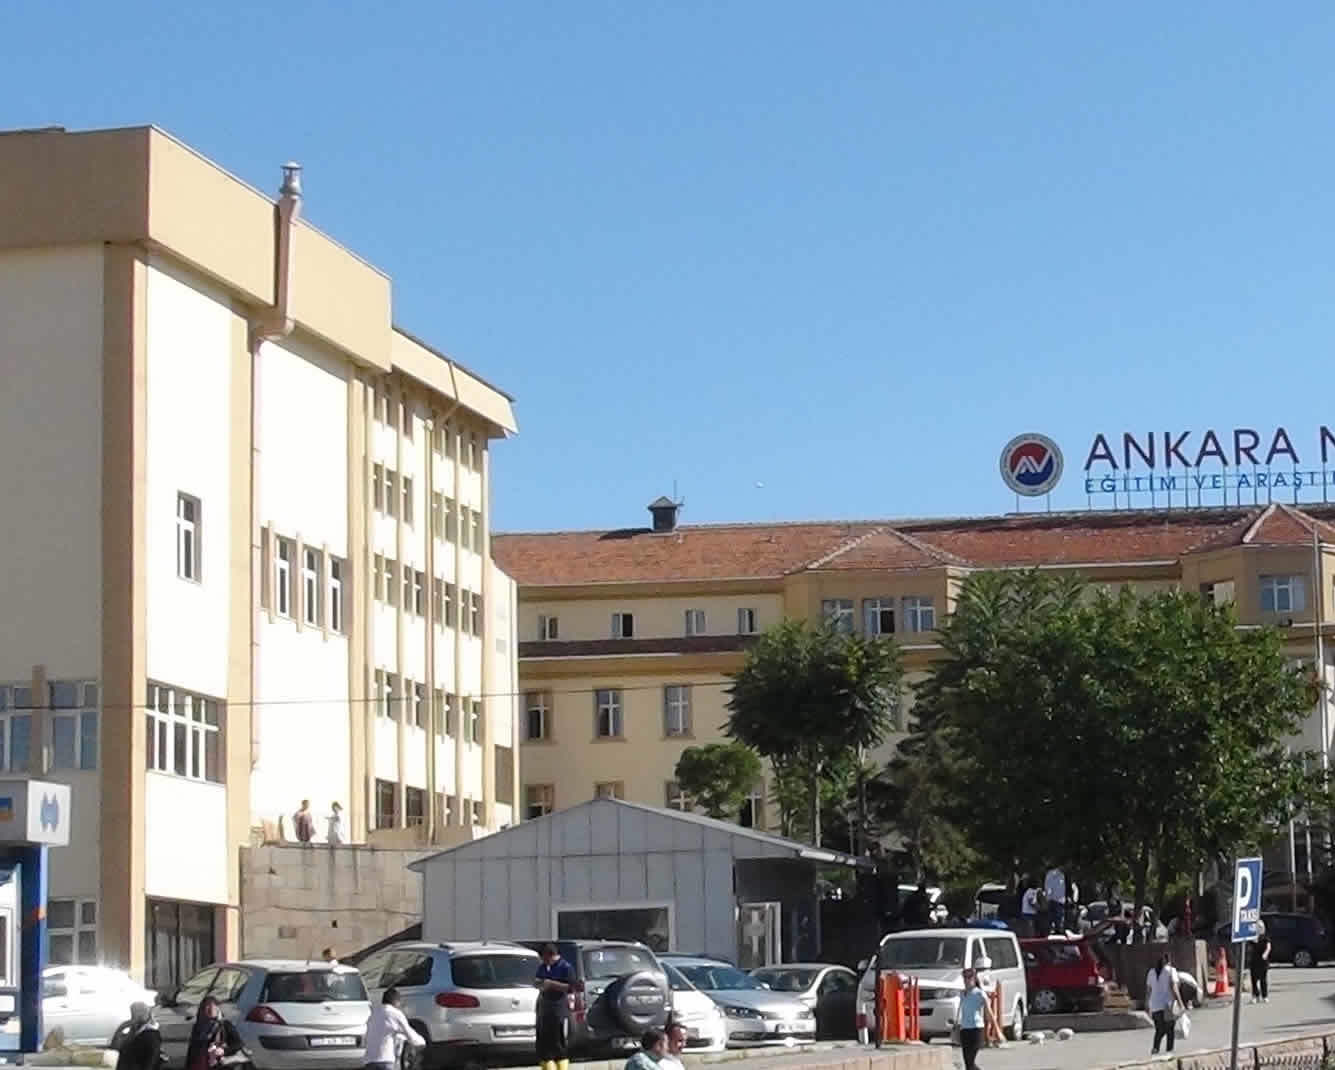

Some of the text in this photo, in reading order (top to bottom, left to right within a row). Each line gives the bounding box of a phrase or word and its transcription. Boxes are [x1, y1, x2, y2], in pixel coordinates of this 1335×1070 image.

[1084, 427, 1300, 471] ANKARA
[1194, 474, 1224, 490] VE
[1235, 867, 1253, 933] P
